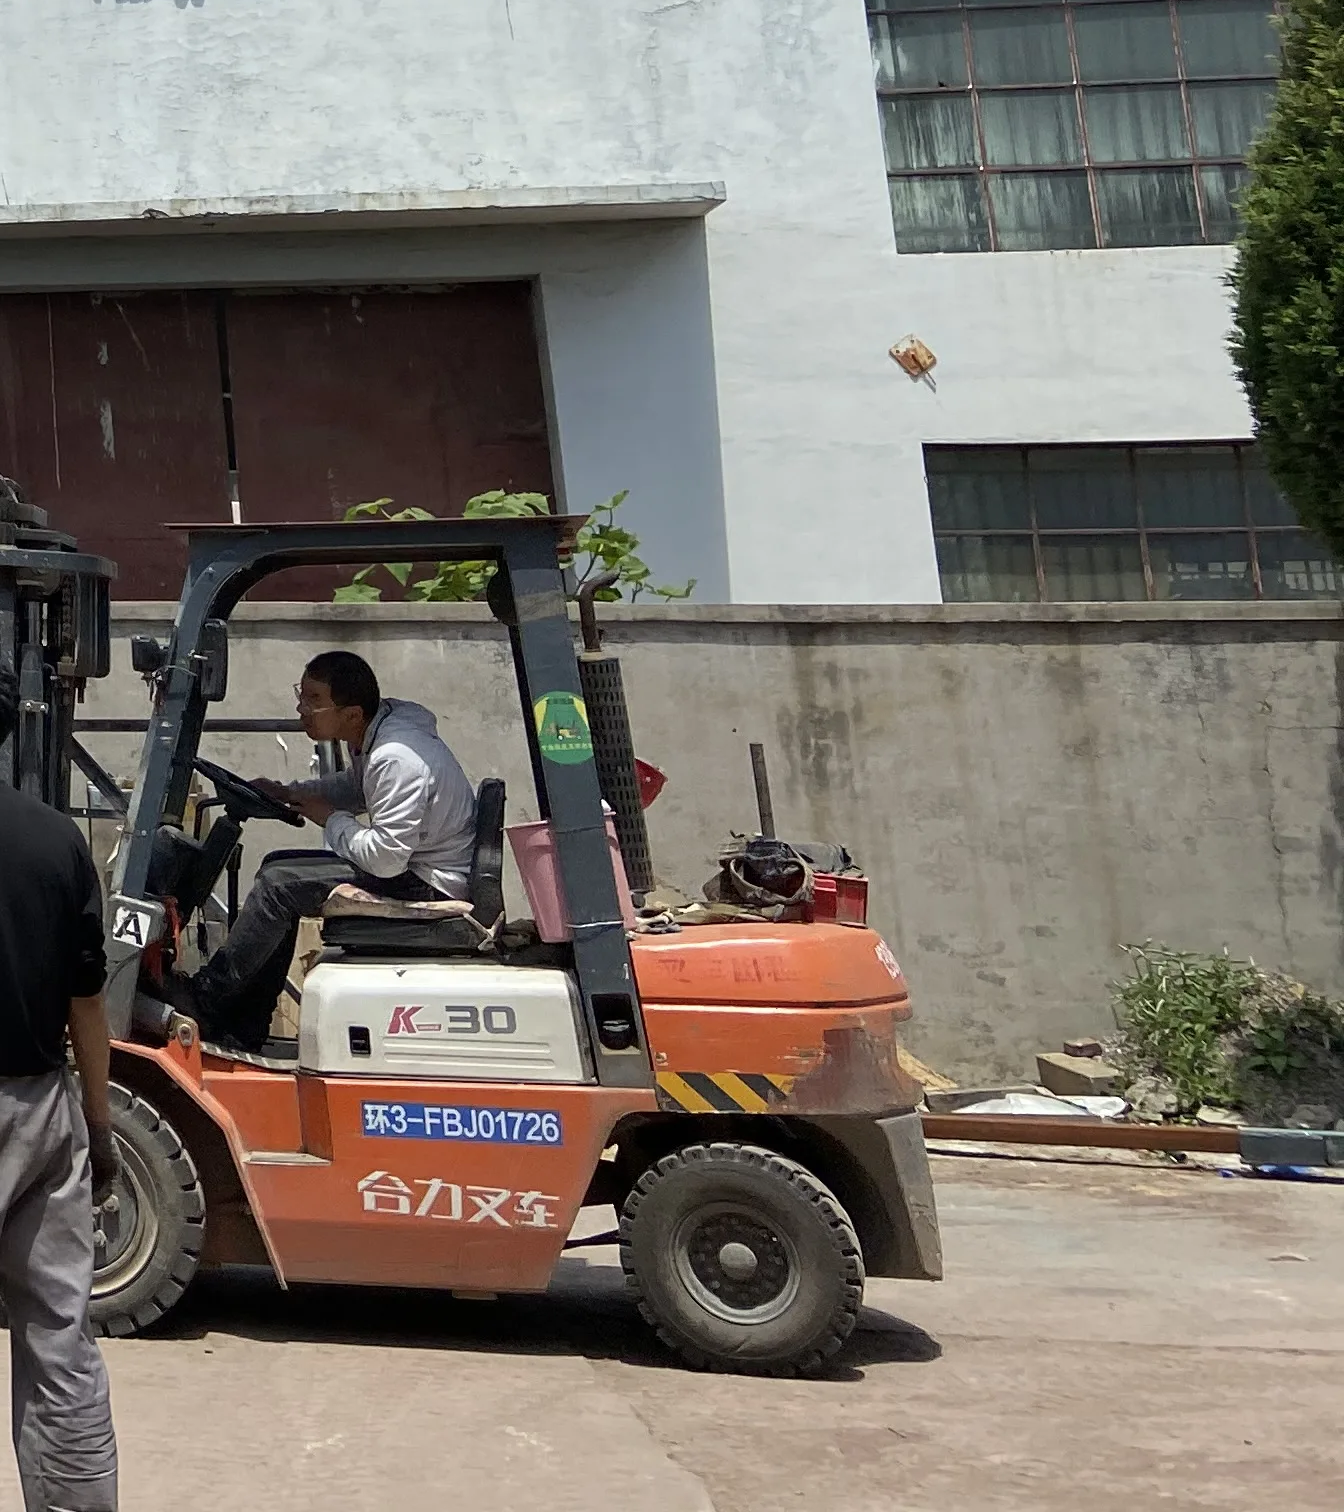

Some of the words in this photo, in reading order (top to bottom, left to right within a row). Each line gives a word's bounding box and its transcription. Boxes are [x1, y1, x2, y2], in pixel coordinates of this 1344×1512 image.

[114, 912, 143, 946] A
[357, 1170, 561, 1228] 合力叉车
